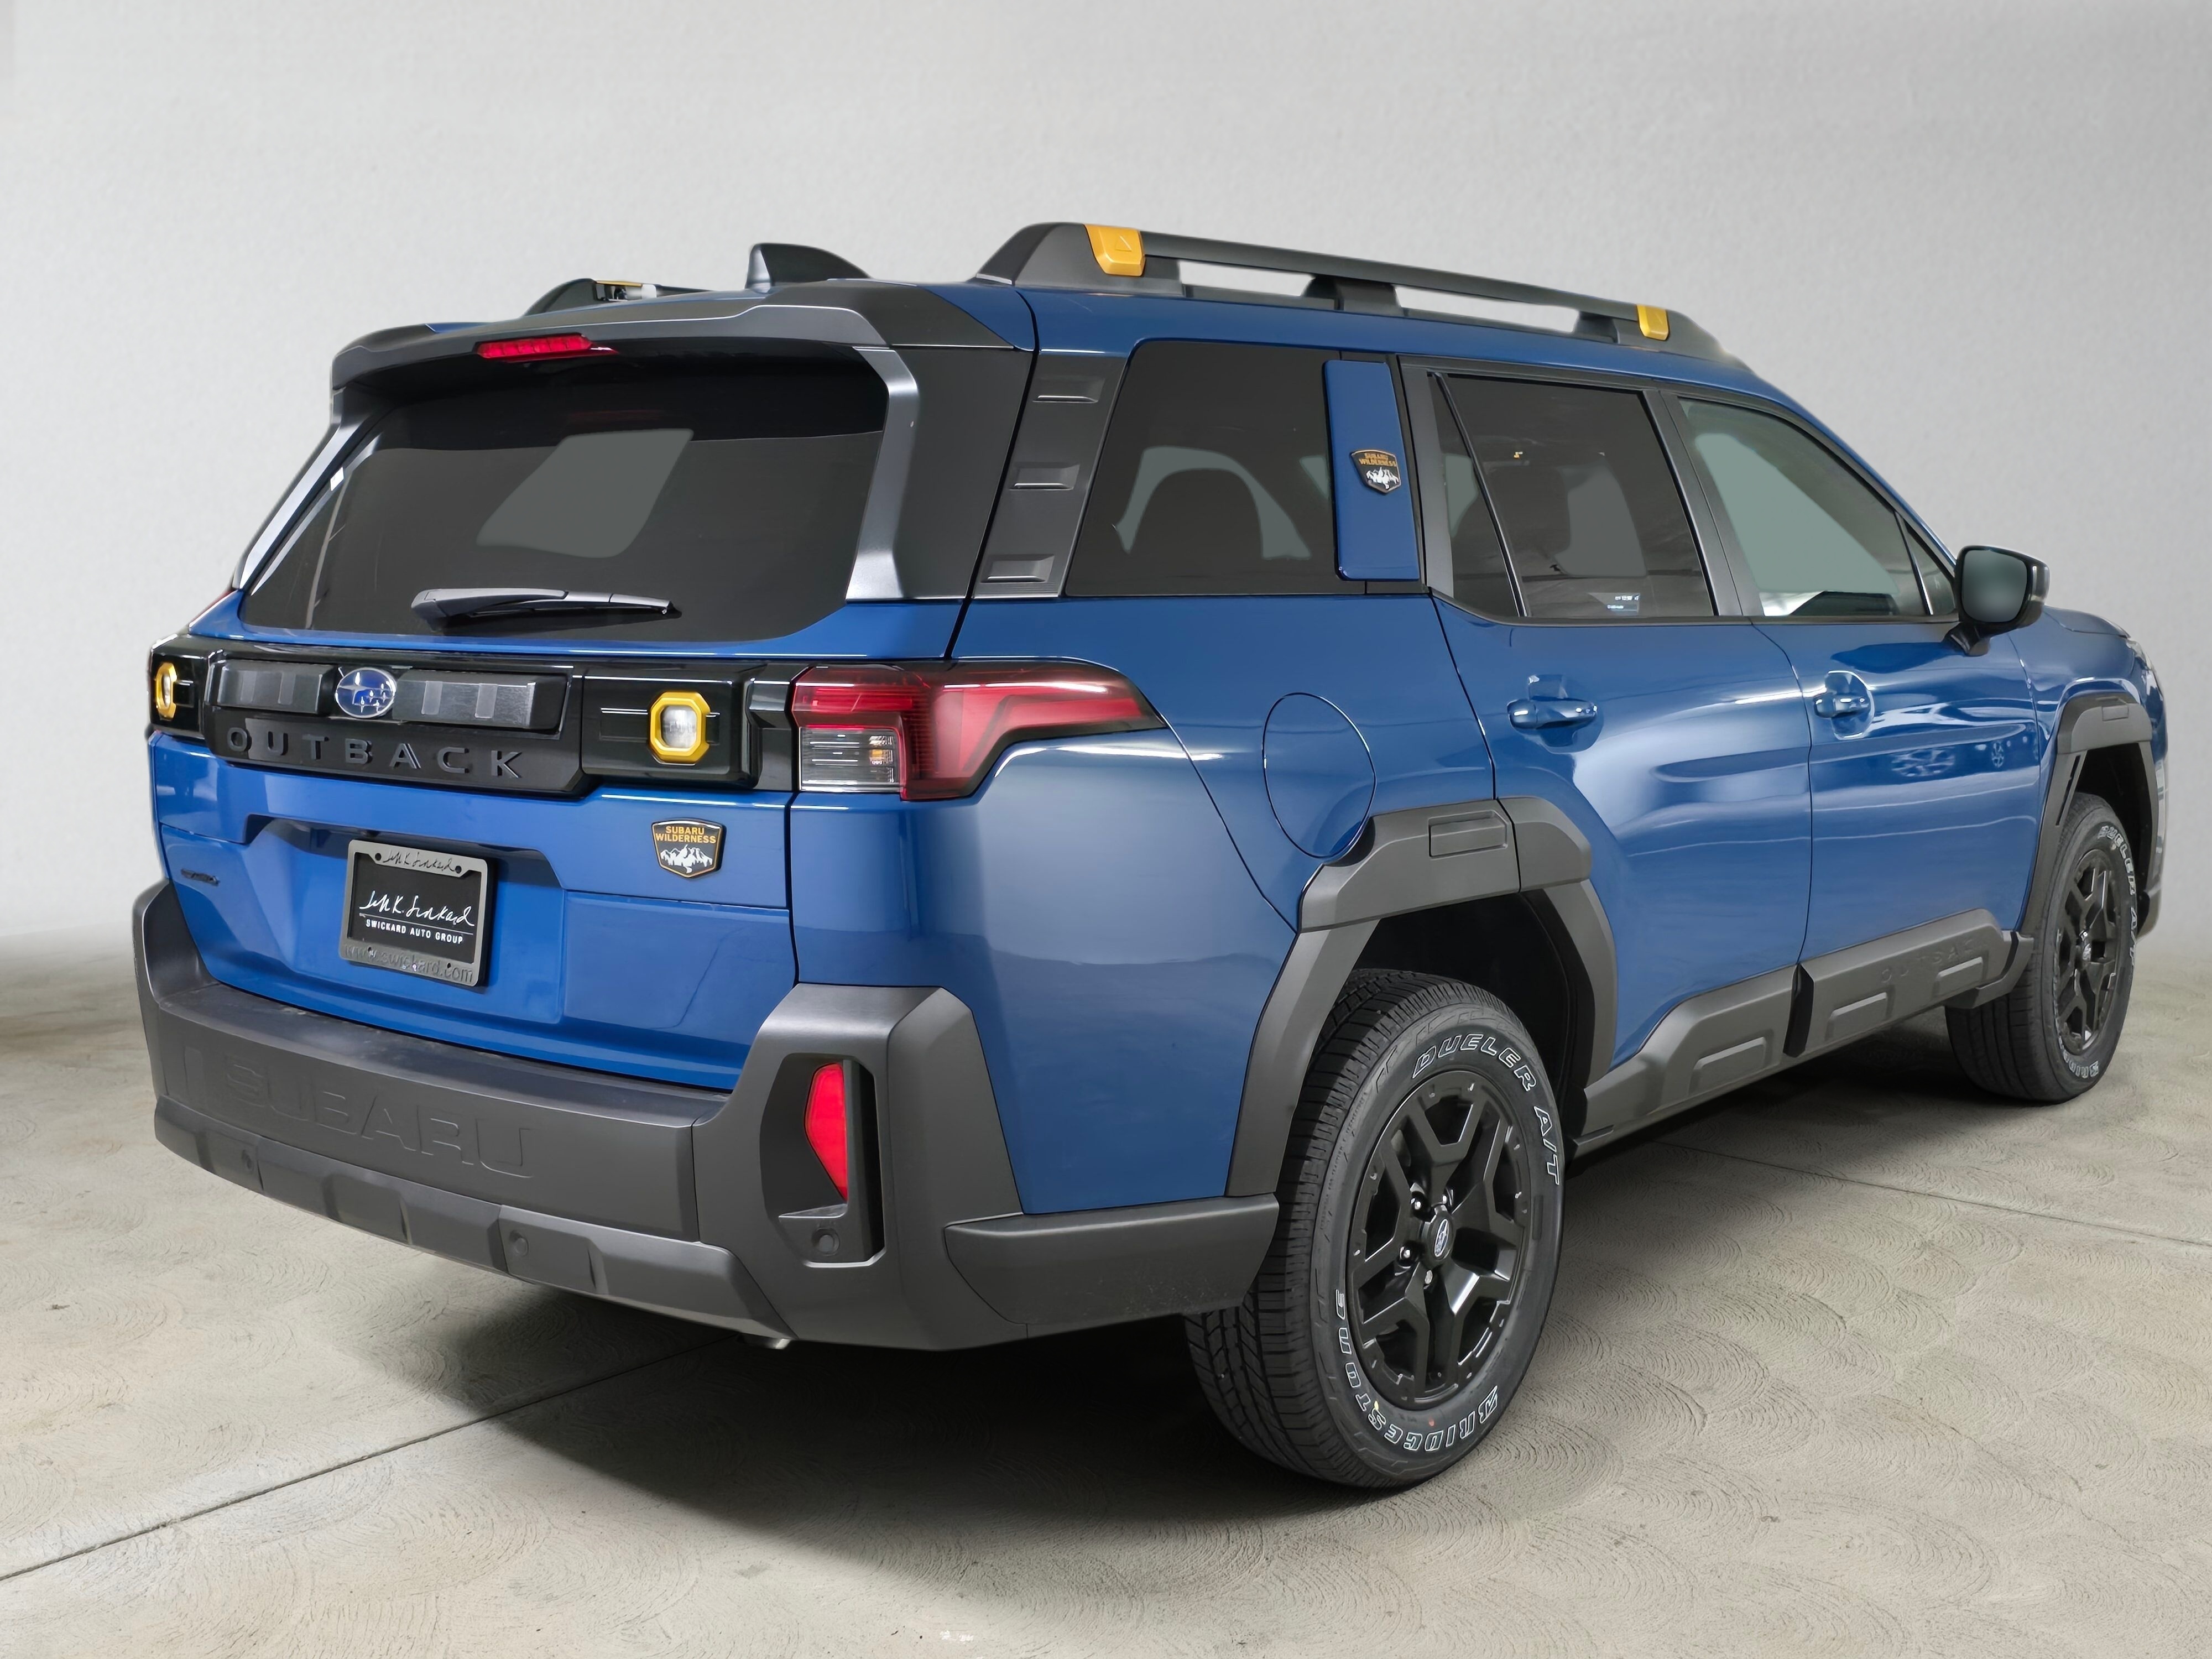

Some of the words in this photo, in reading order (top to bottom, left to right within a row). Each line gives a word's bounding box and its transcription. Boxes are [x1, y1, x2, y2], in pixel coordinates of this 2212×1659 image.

[226, 726, 523, 779] OUTBACK
[656, 833, 717, 844] WILDERNESS
[665, 826, 705, 835] SUBARU
[366, 919, 406, 934] SWICKARD
[410, 927, 431, 938] AUTO
[435, 932, 463, 945] GROUP
[225, 1055, 534, 1178] SUBARU
[1412, 1034, 1536, 1092] DUELER
[1533, 1106, 1559, 1186] A/T
[1335, 1288, 1499, 1452] BRIDGESTONE
